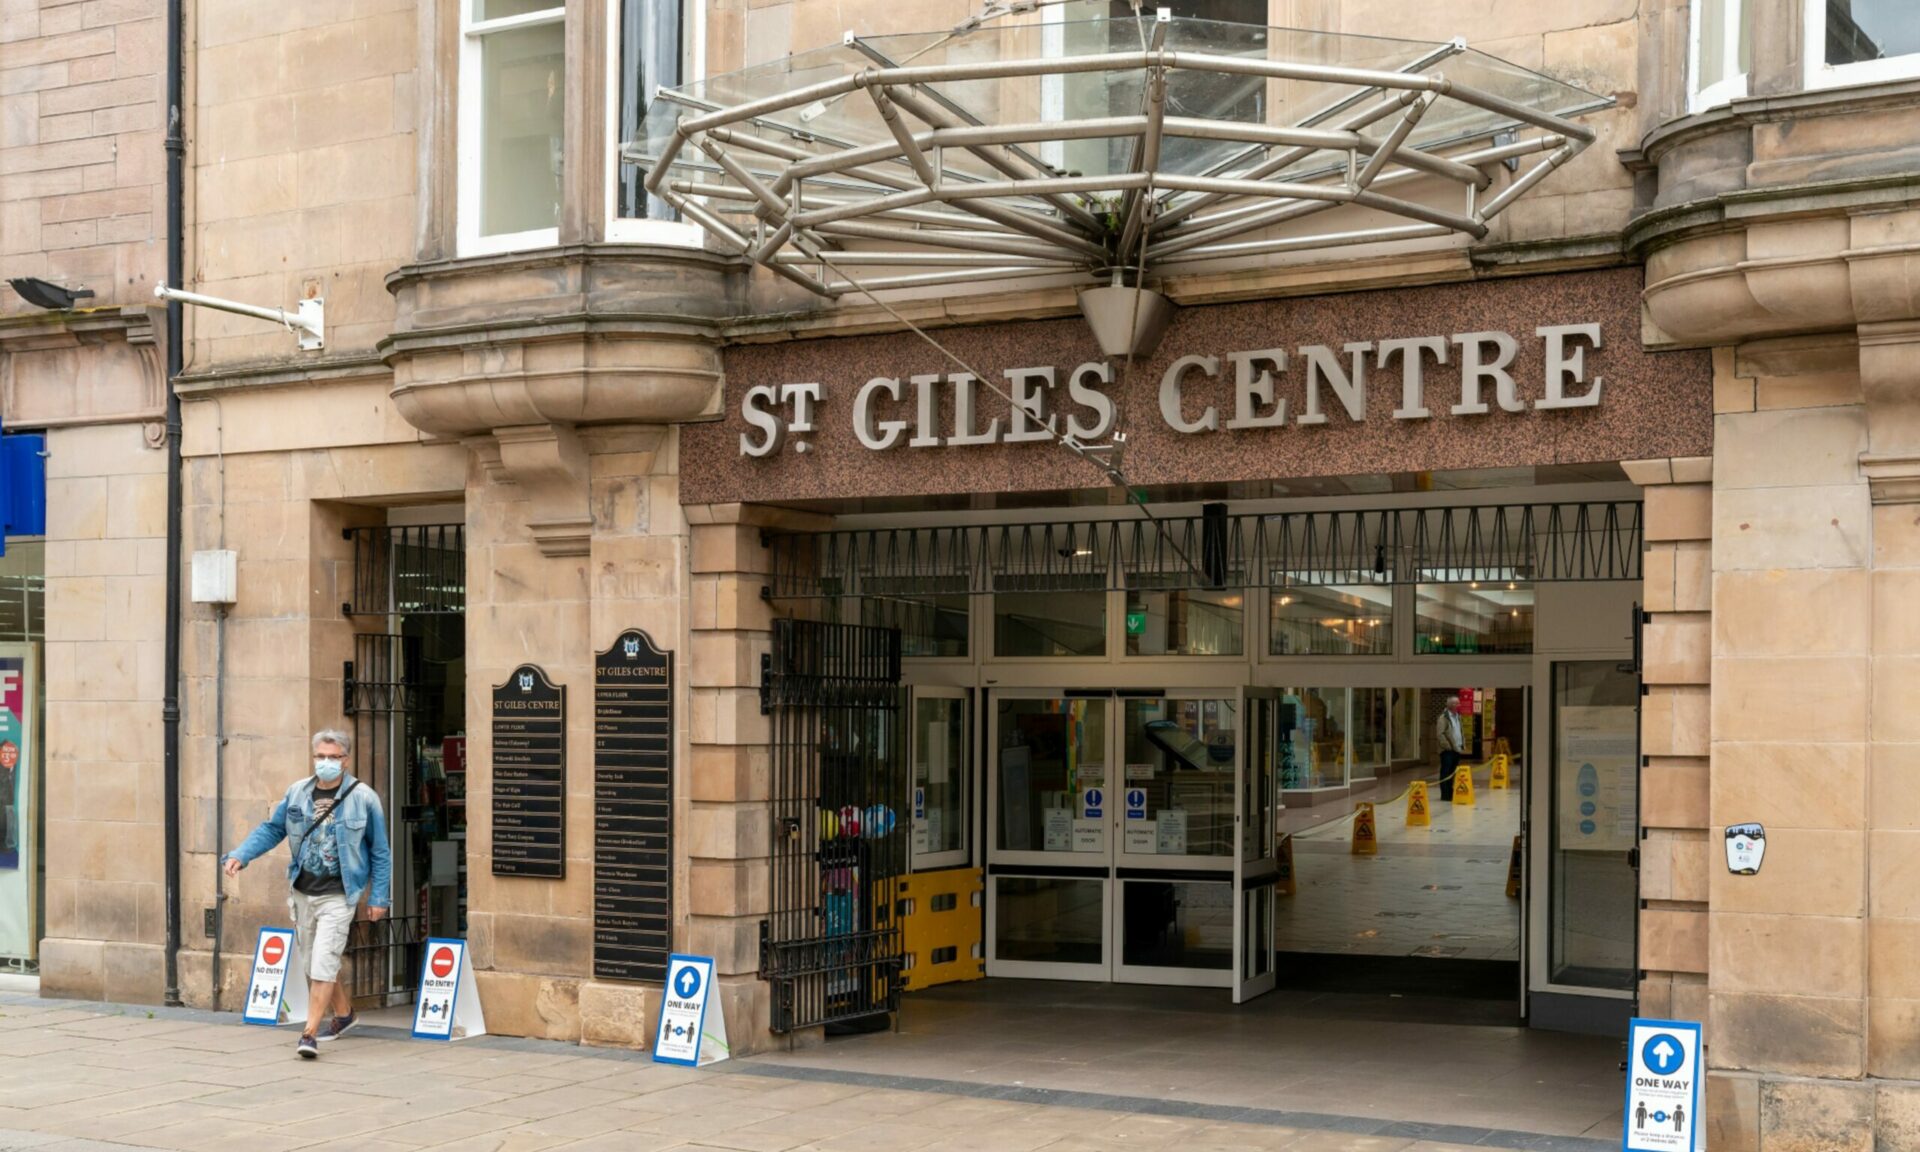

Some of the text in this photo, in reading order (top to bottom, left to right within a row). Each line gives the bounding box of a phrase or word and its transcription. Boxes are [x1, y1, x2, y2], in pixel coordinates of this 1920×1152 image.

[852, 361, 1116, 451] GILES
[1158, 322, 1603, 434] CENTRE
[597, 667, 666, 676] ST GILES CENTRE
[494, 701, 560, 709] ST GILES CENTRE
[435, 980, 454, 988] ENTRY
[667, 1000, 701, 1011] ONE WAY
[1635, 1077, 1690, 1090] ONE WAY
